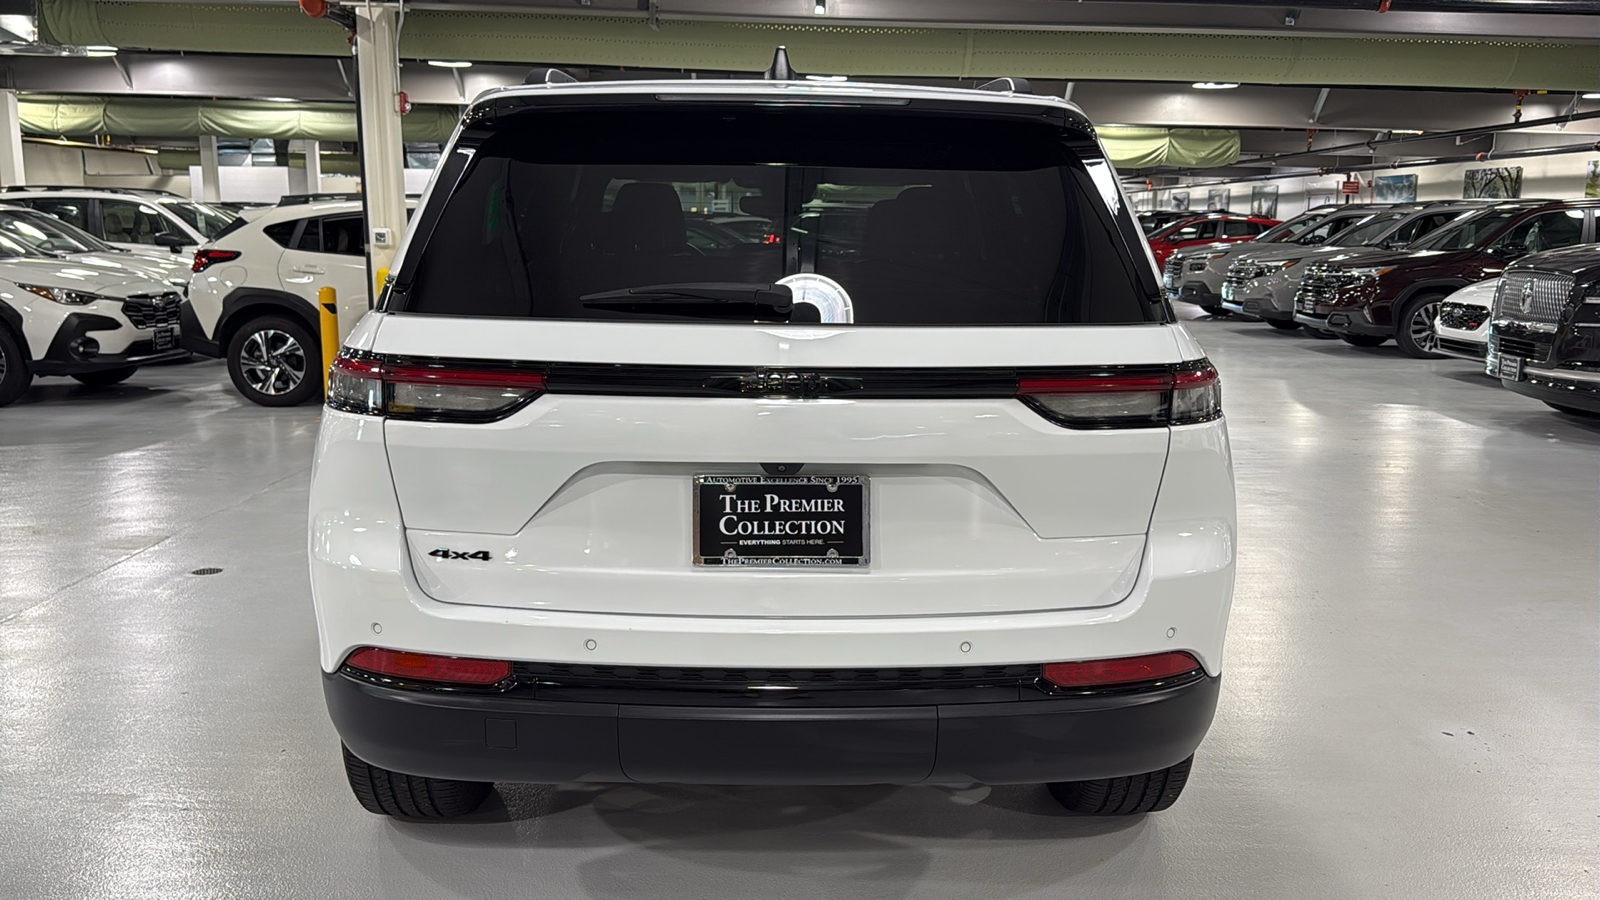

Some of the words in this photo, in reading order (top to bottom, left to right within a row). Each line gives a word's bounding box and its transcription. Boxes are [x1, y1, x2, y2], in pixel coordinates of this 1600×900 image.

[719, 494, 761, 513] THE
[764, 494, 845, 513] PREMIER
[719, 515, 845, 535] COLLECTION
